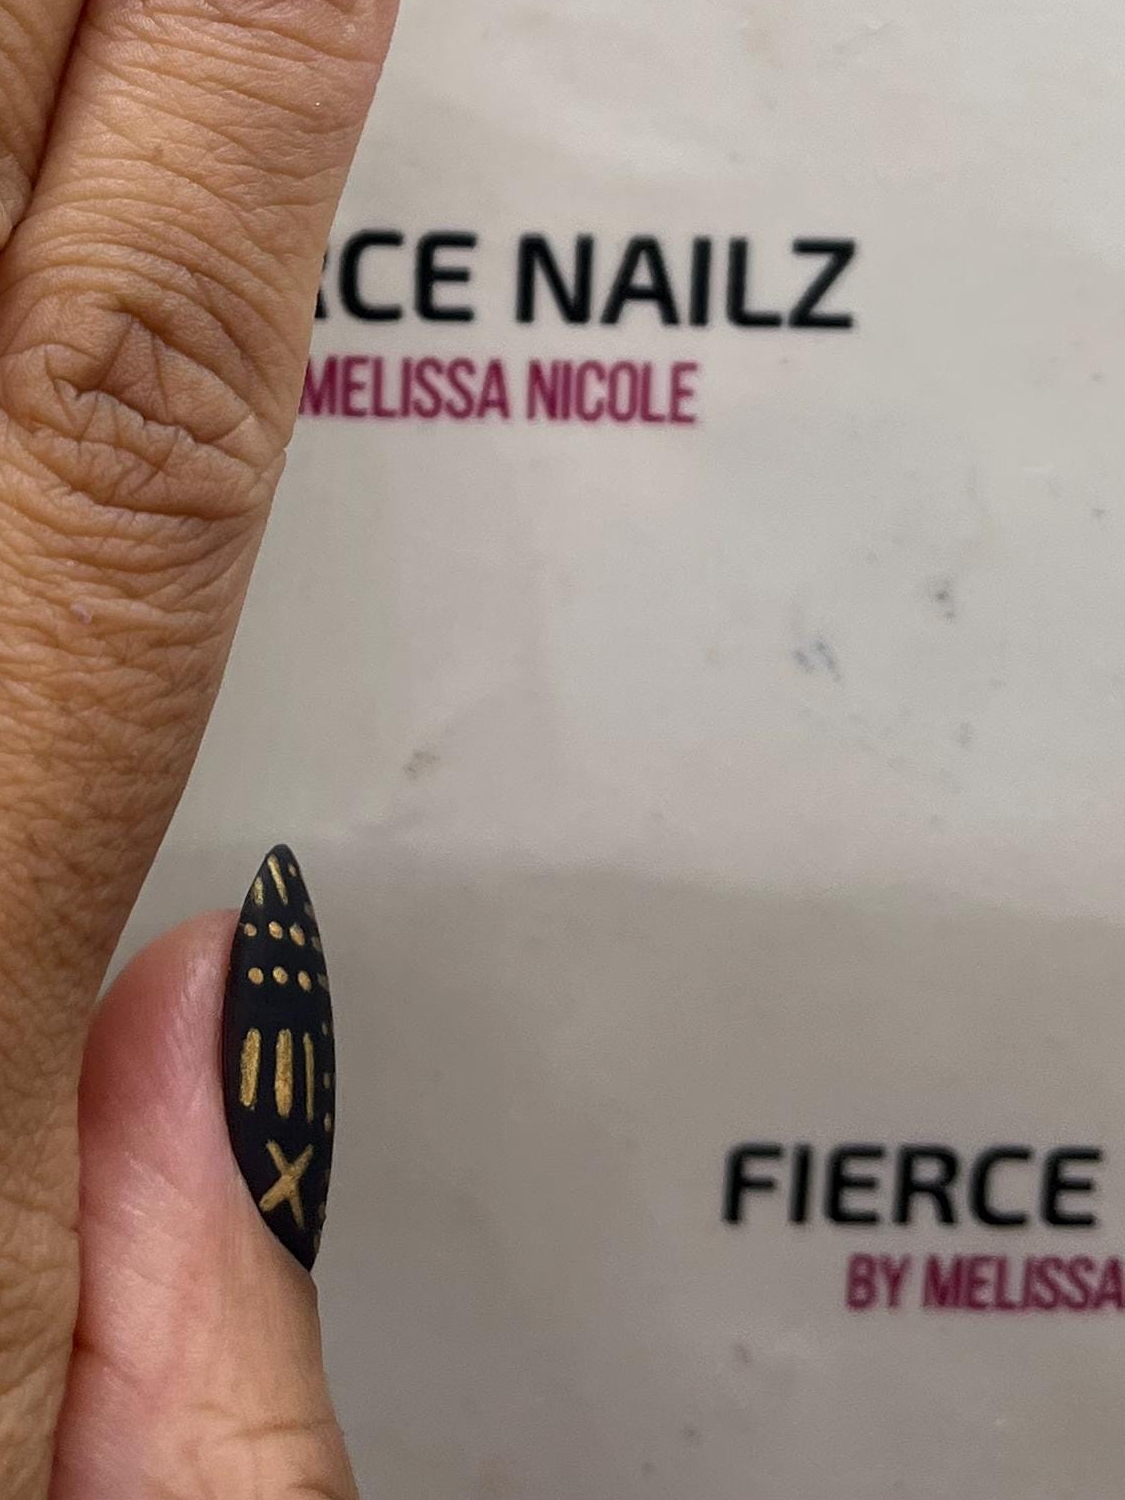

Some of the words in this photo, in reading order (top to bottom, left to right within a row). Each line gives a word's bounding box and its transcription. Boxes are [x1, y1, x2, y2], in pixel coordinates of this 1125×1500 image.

[516, 234, 857, 331] NAILZ
[301, 356, 513, 422] MELISSA
[527, 361, 699, 427] NICOLE
[722, 1143, 1105, 1232] FIERCE
[846, 1254, 912, 1313] BY
[923, 1255, 1125, 1316] MELISSA
